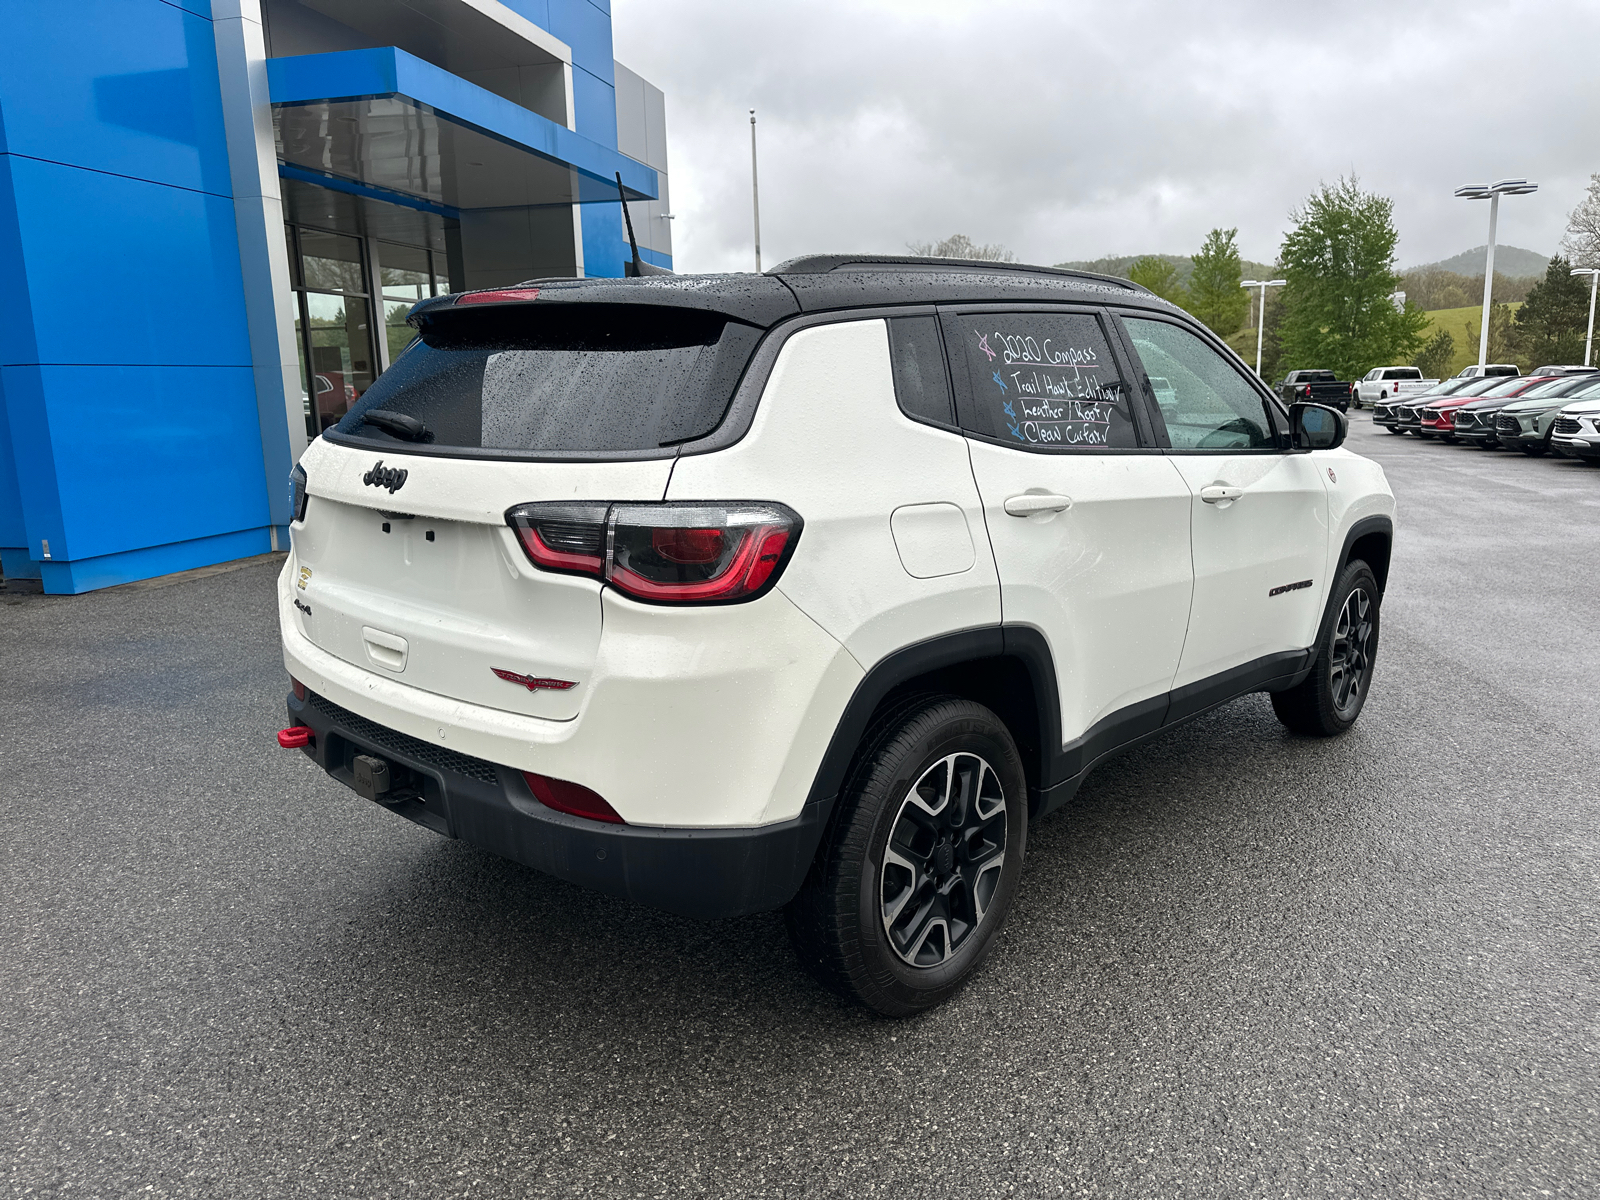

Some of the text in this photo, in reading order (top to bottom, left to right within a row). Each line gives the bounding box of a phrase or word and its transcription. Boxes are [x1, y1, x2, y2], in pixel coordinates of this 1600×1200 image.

[995, 332, 1097, 380] 2020 Compass
[1010, 371, 1041, 394] Trail
[1043, 374, 1074, 398] Hawk
[1074, 401, 1100, 421] Roof
[363, 460, 408, 494] Jeep
